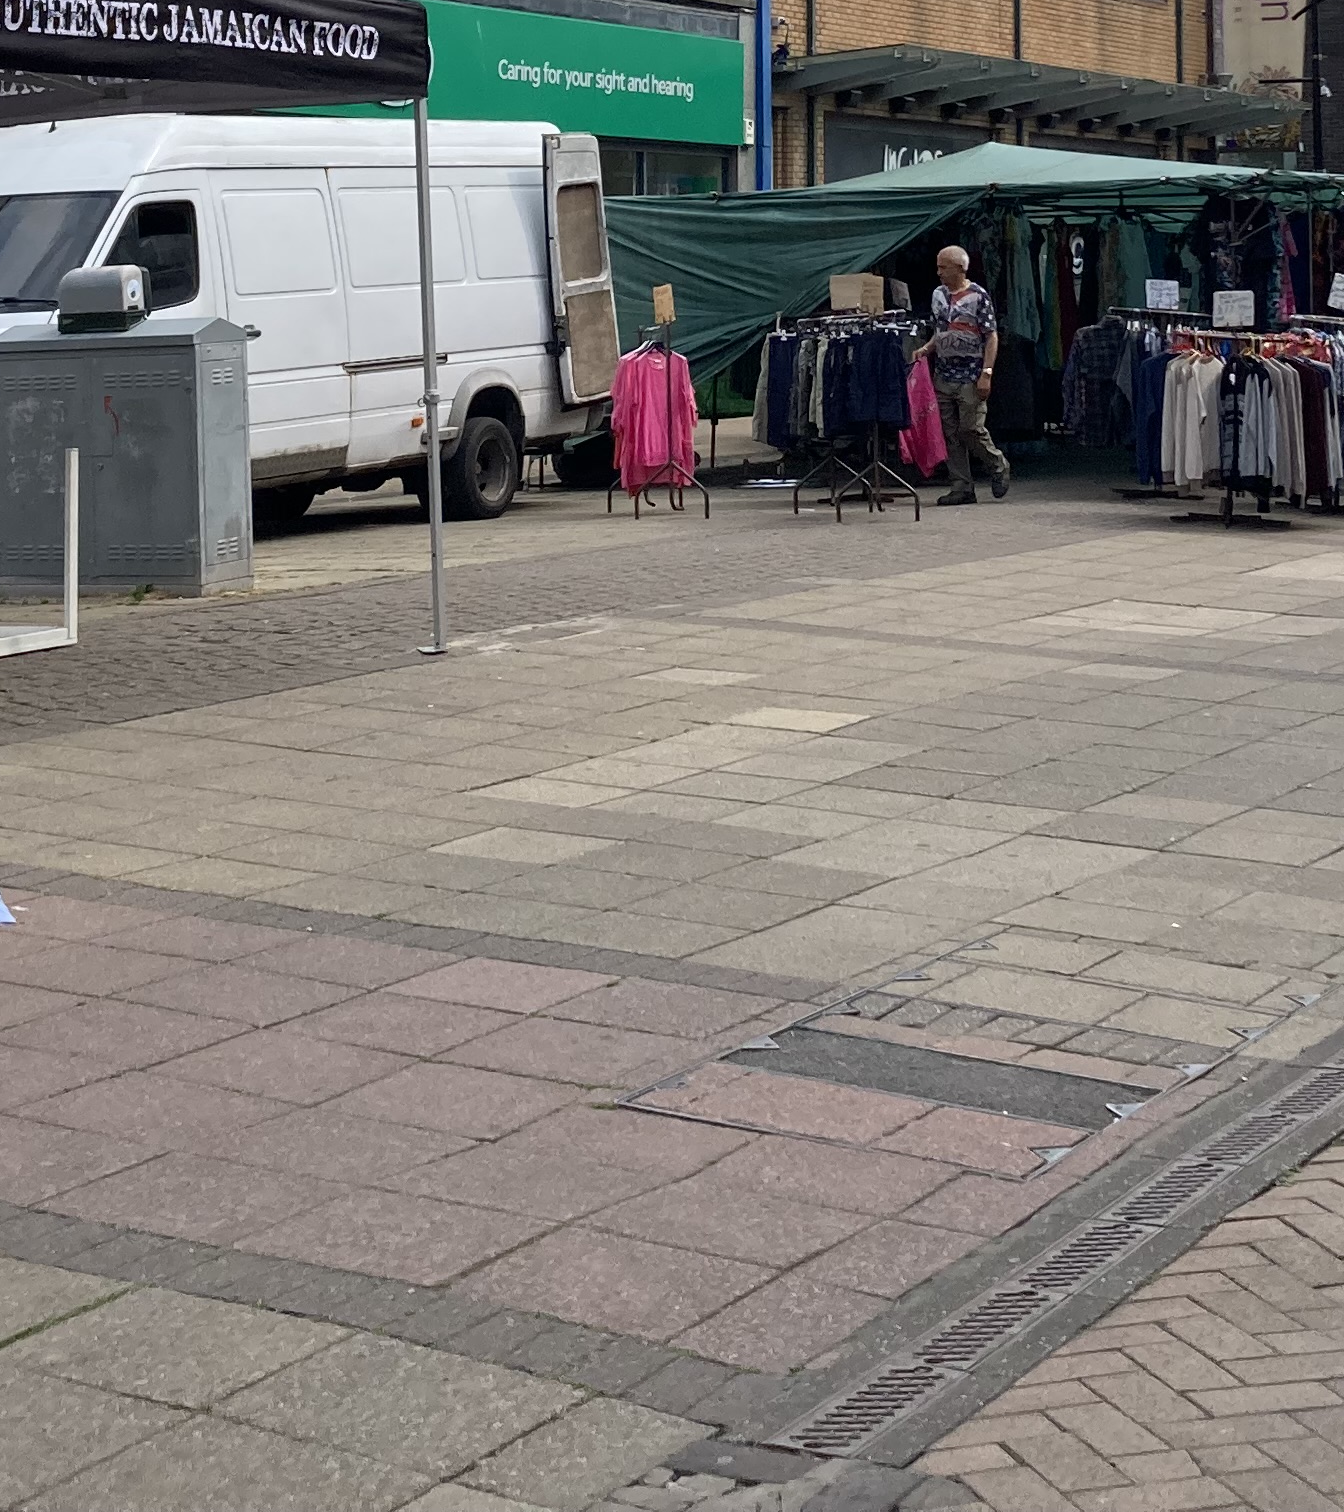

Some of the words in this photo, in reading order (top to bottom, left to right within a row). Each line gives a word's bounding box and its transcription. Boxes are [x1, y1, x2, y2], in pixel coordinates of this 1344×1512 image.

[162, 4, 310, 54] JAMAICAN
[311, 20, 380, 60] FOOD
[497, 58, 541, 88] Caring
[543, 61, 562, 85] for
[565, 70, 594, 91] your
[595, 68, 626, 95] sight
[627, 74, 650, 93] and
[651, 74, 694, 103] hearing
